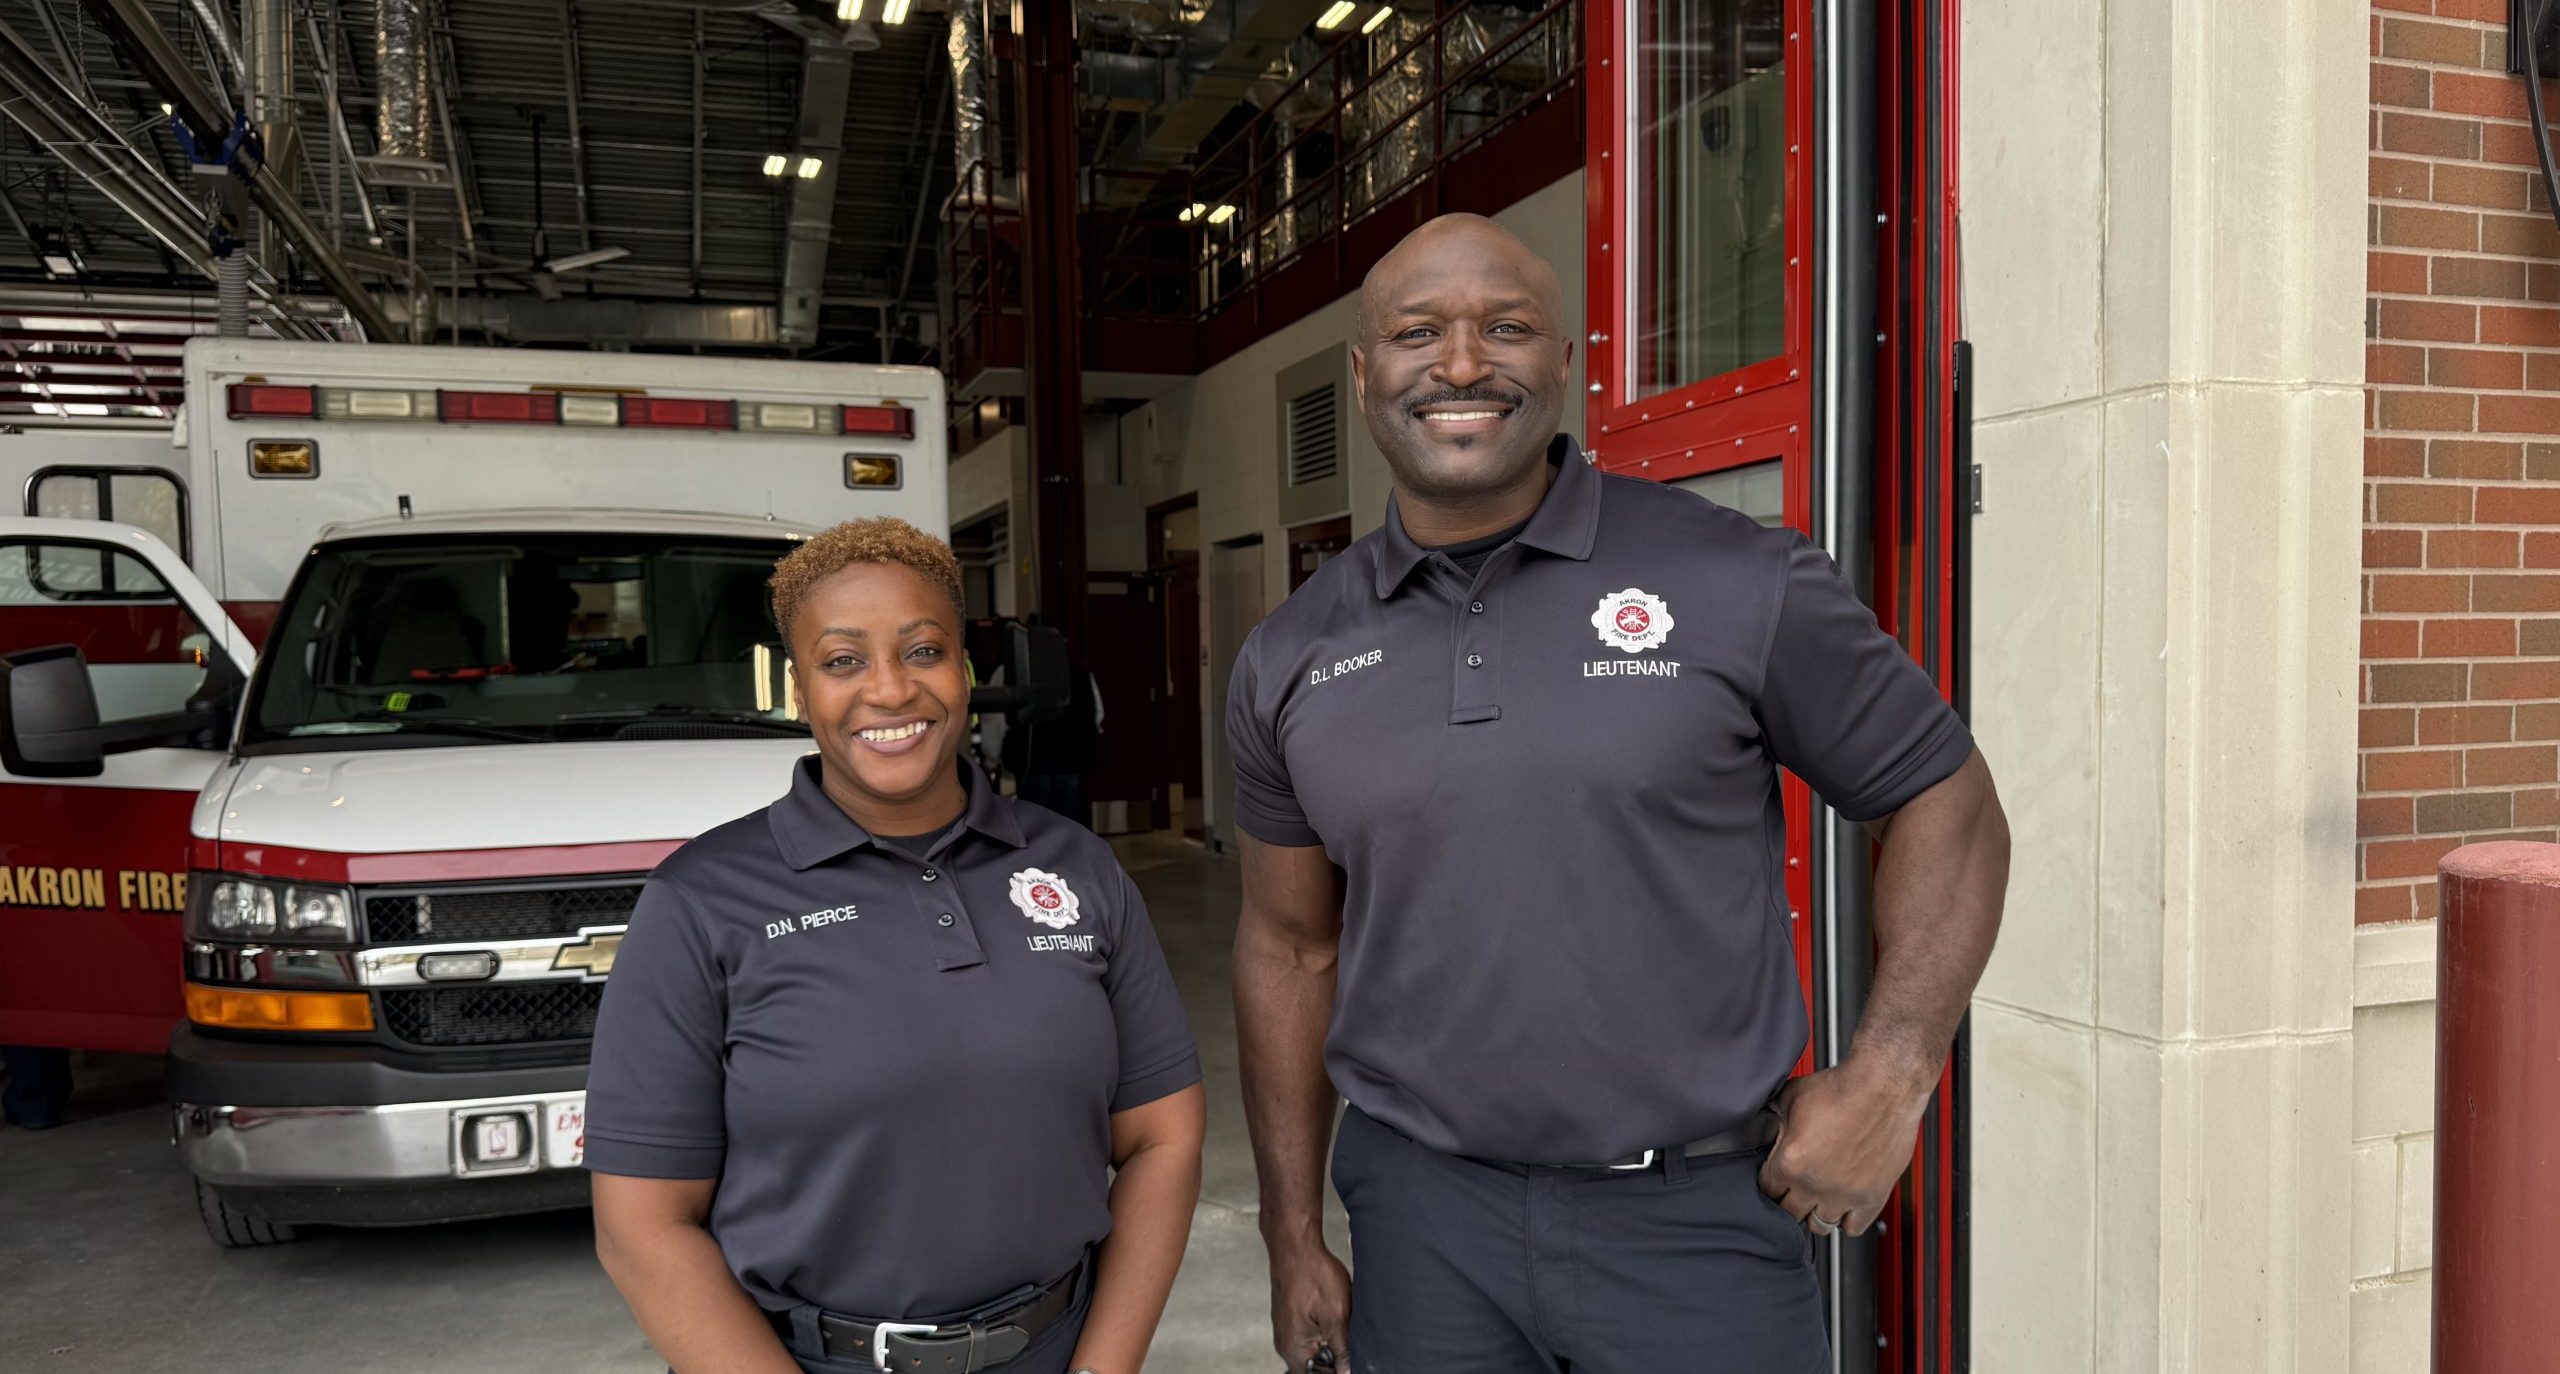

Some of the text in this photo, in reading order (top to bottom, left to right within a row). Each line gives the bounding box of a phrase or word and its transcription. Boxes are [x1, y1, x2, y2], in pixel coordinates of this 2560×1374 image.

[1619, 598, 1648, 607] AKRON
[1611, 628, 1629, 641] FIRE
[1311, 649, 1383, 685] D.L. BOOKER
[1583, 660, 1681, 678] LIEUTENANT
[0, 866, 187, 912] AKRON FIRE
[765, 904, 859, 940] D.N. PIERCE
[1026, 934, 1095, 953] LIEUTENANT
